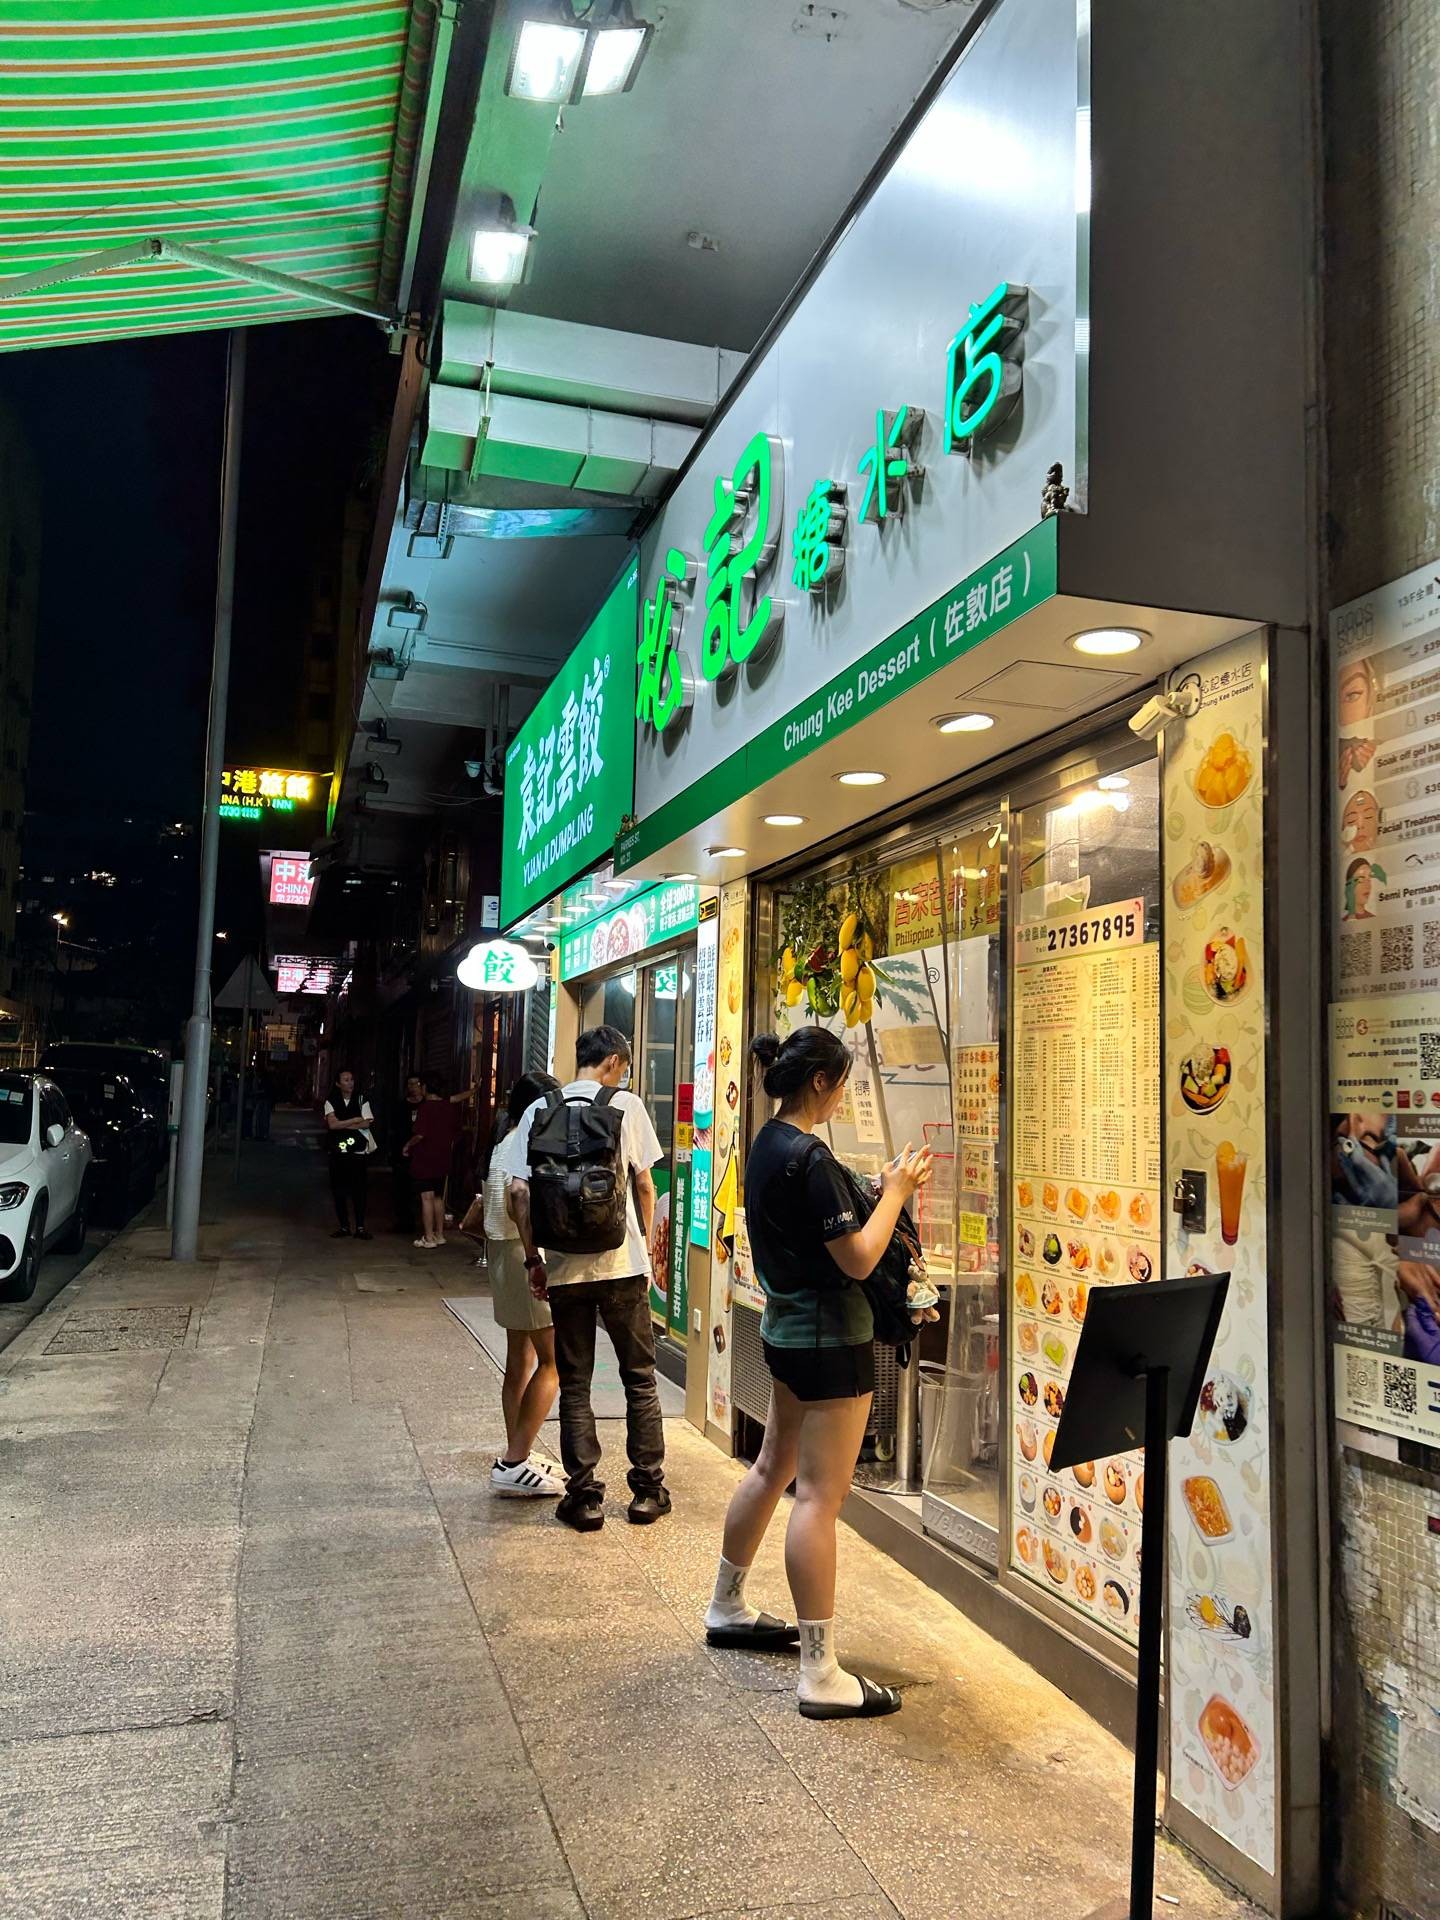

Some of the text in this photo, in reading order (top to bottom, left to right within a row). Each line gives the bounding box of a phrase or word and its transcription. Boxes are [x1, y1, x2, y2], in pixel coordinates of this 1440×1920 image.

[783, 709, 824, 751] Chung
[827, 687, 854, 723] Kee
[857, 633, 920, 703] Dessert
[550, 803, 593, 866] DUMPLING
[275, 883, 309, 894] CHINA
[1378, 889, 1400, 902] Semi
[895, 926, 934, 947] Philippine
[1047, 913, 1135, 951] 27367895
[483, 949, 515, 984] 餃
[855, 1080, 870, 1097] 招聘
